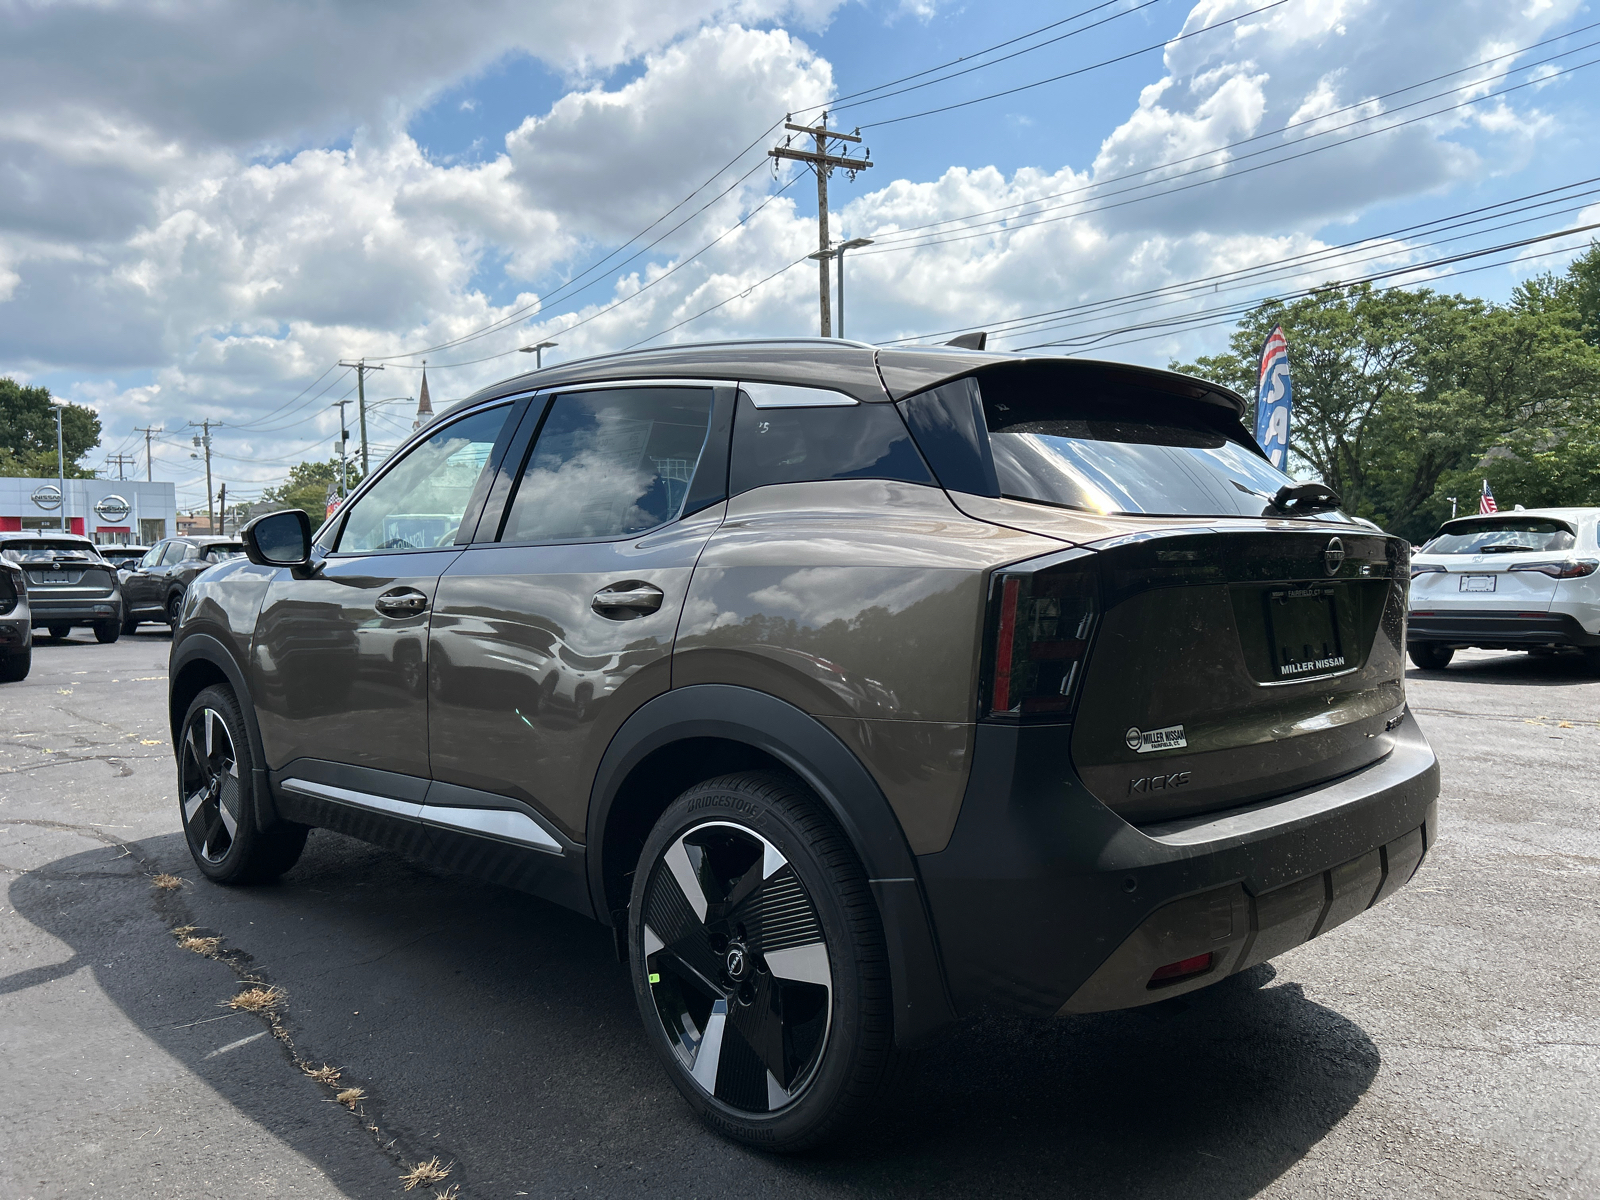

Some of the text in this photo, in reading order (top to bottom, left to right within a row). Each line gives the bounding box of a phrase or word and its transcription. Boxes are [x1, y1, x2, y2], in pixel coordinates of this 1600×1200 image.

[1281, 657, 1345, 675] MILLER NISSAN
[1143, 729, 1185, 745] MILLER NISSAN
[1127, 771, 1192, 795] KICKS
[686, 795, 759, 816] BRIDGESTONE
